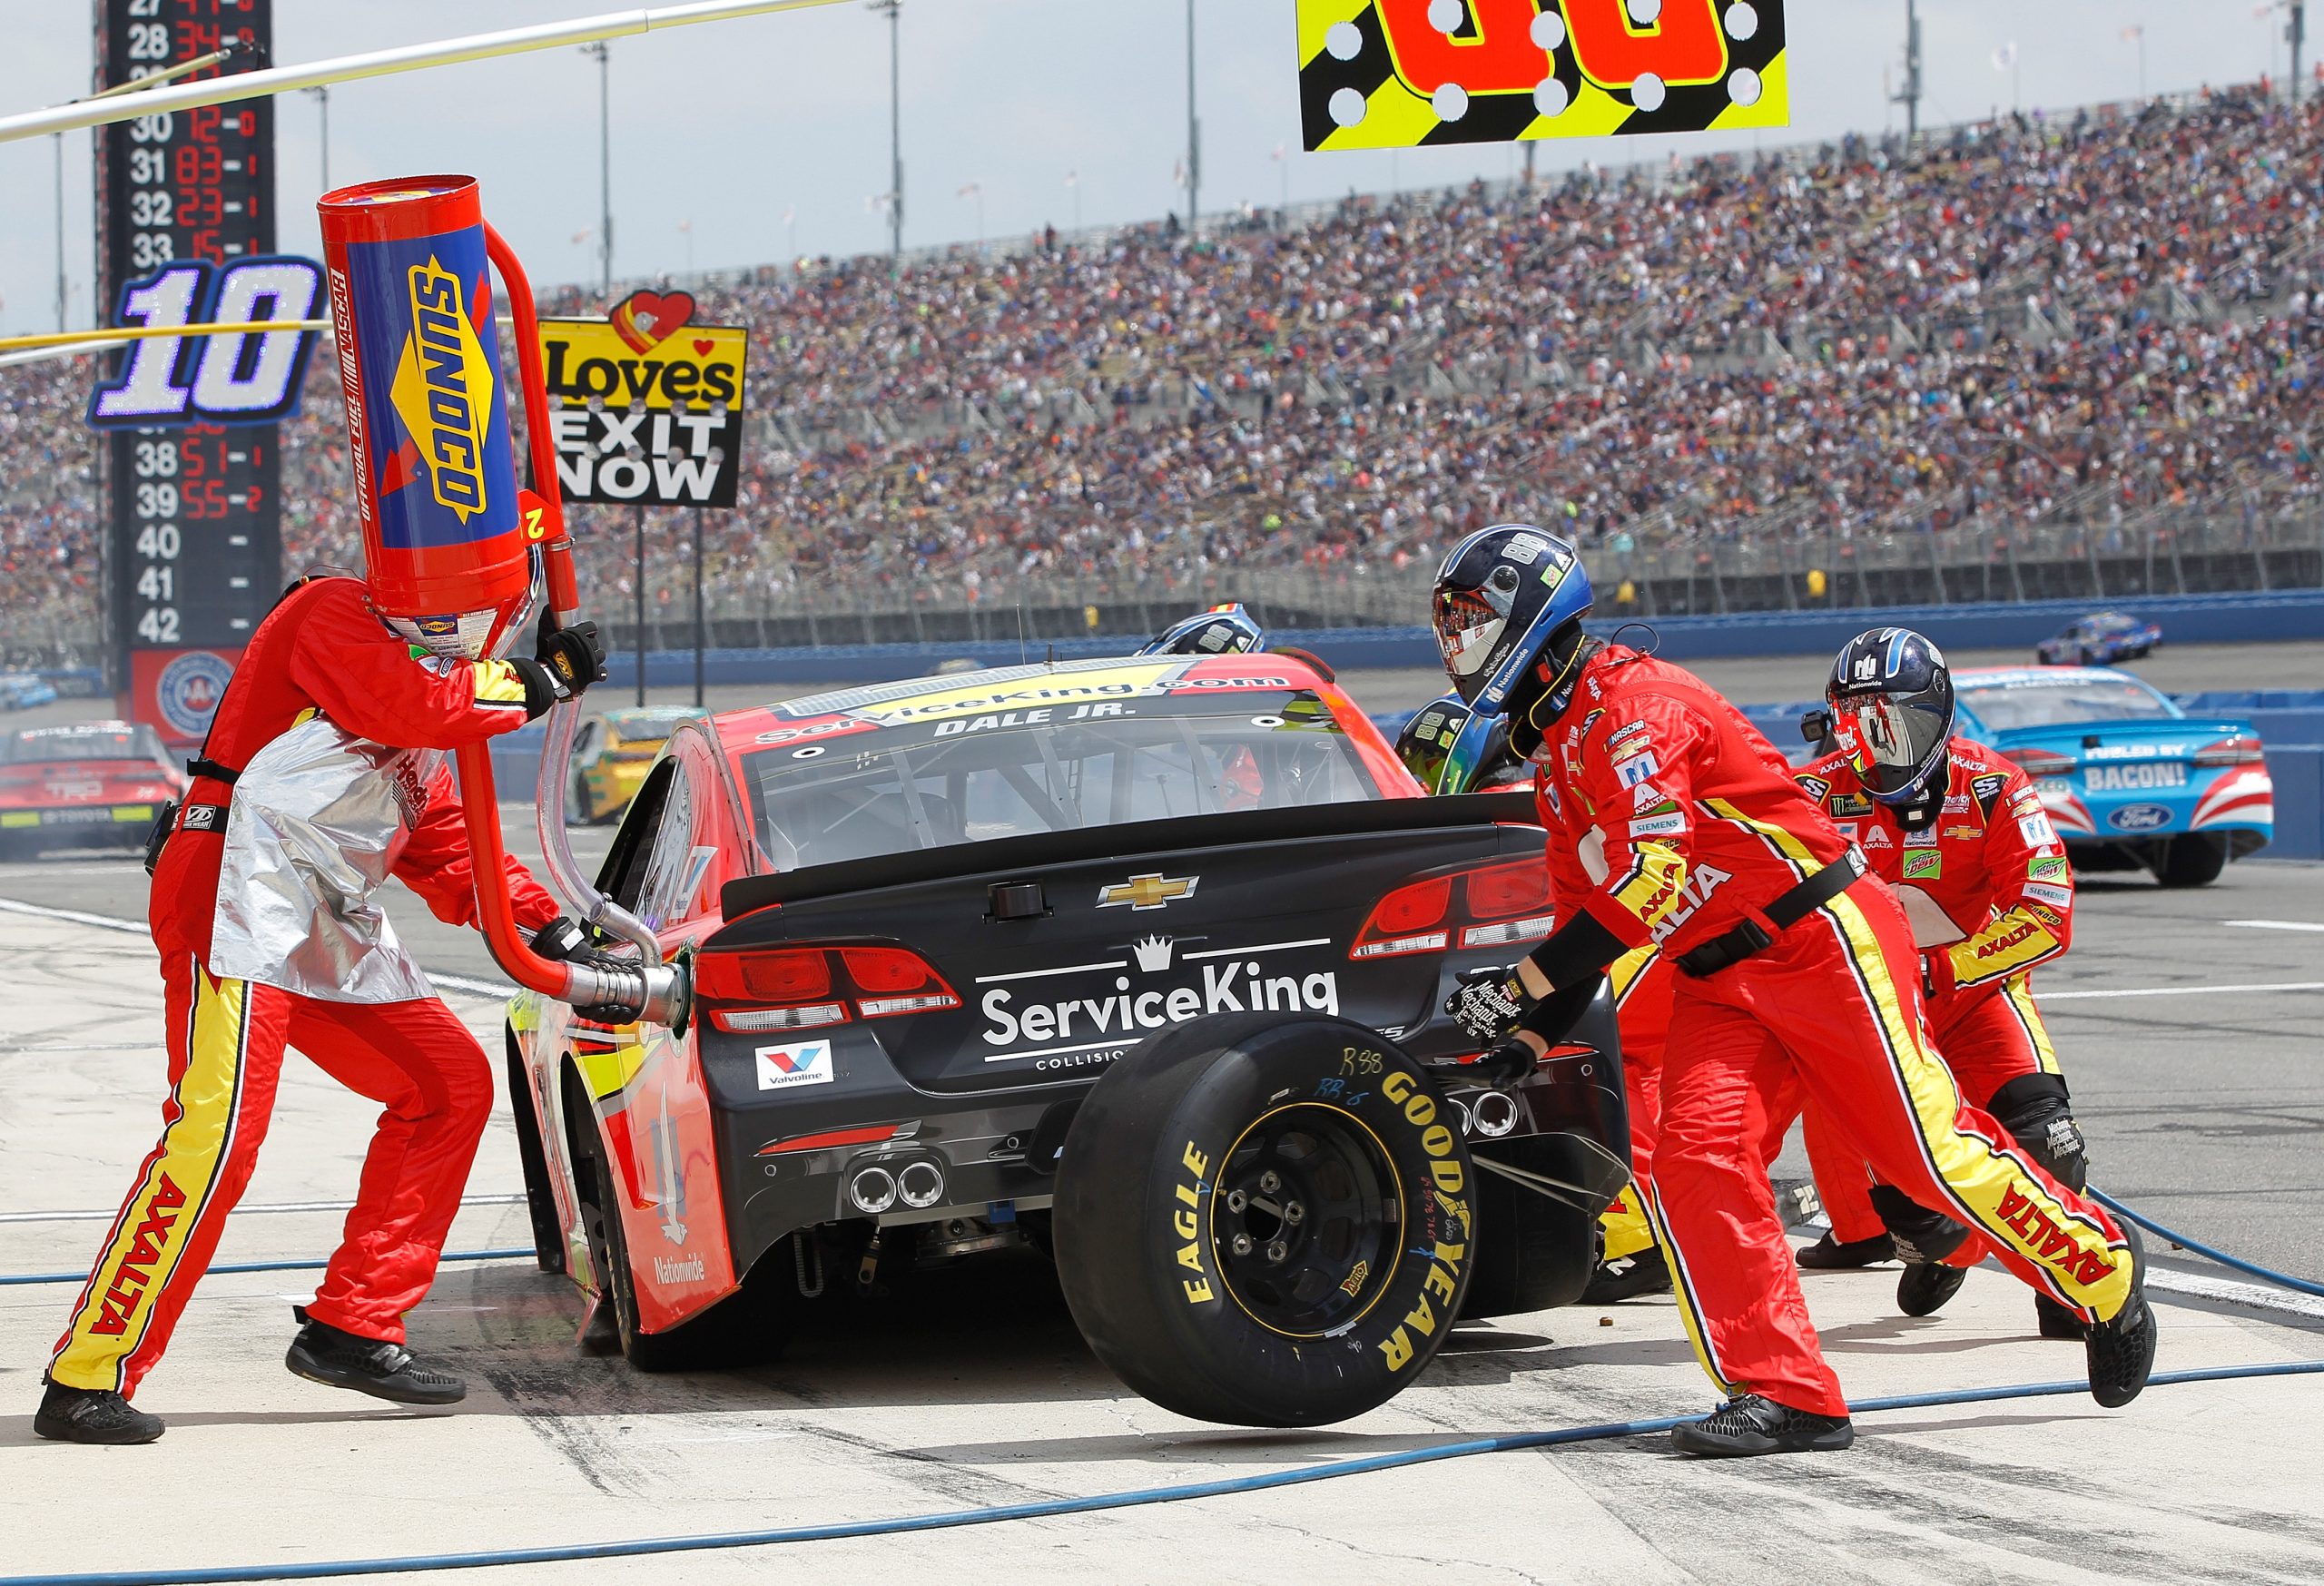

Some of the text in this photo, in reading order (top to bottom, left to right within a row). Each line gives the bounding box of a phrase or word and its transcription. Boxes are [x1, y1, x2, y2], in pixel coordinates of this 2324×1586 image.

[128, 23, 170, 60] 28
[130, 147, 165, 183] 31
[175, 145, 222, 185] 83
[131, 190, 173, 227] 32
[177, 187, 222, 227] 23
[133, 232, 174, 269] 33
[330, 268, 356, 357] NASCAR
[94, 262, 319, 418] 10
[410, 268, 485, 509] SUNOCO
[546, 340, 736, 404] Loves
[549, 410, 726, 458] EXIT
[135, 440, 179, 478] 38
[181, 438, 227, 478] 51
[347, 394, 371, 522] OFFICIAL FUEL
[555, 454, 723, 501] NOW
[136, 482, 179, 519] 39
[181, 479, 229, 519] 55
[526, 507, 545, 539] 2
[136, 524, 181, 560] 40
[1501, 532, 1548, 565] 88
[137, 566, 173, 601] 41
[138, 607, 181, 644] 42
[1198, 624, 1234, 652] 88
[1497, 647, 1530, 689] Nationwide
[1848, 680, 1883, 690] Nationwide
[932, 702, 1137, 737] DALE JR.
[1415, 712, 1446, 741] 88
[1610, 718, 1646, 743] NASCAR
[1819, 758, 1847, 774] AXAL
[1949, 754, 1987, 773] AXALTA
[2083, 763, 2187, 792] BACON!
[1634, 793, 1668, 816] AXALTA
[1636, 819, 1679, 832] SIEMENS
[1862, 842, 1894, 850] AXALTA
[1649, 862, 1734, 949] ALTA
[2029, 886, 2065, 901] SIEMENS
[1977, 921, 2040, 960] AXALTA
[981, 960, 1339, 1046] ServiceKing
[769, 1070, 822, 1085] Valvoline
[1035, 1049, 1128, 1070] COLLISIO
[1174, 1139, 1216, 1305] EAGLE
[1995, 1178, 2119, 1286] AXALTA
[88, 1170, 188, 1336] AXALTA
[653, 1256, 704, 1286] Nationwide
